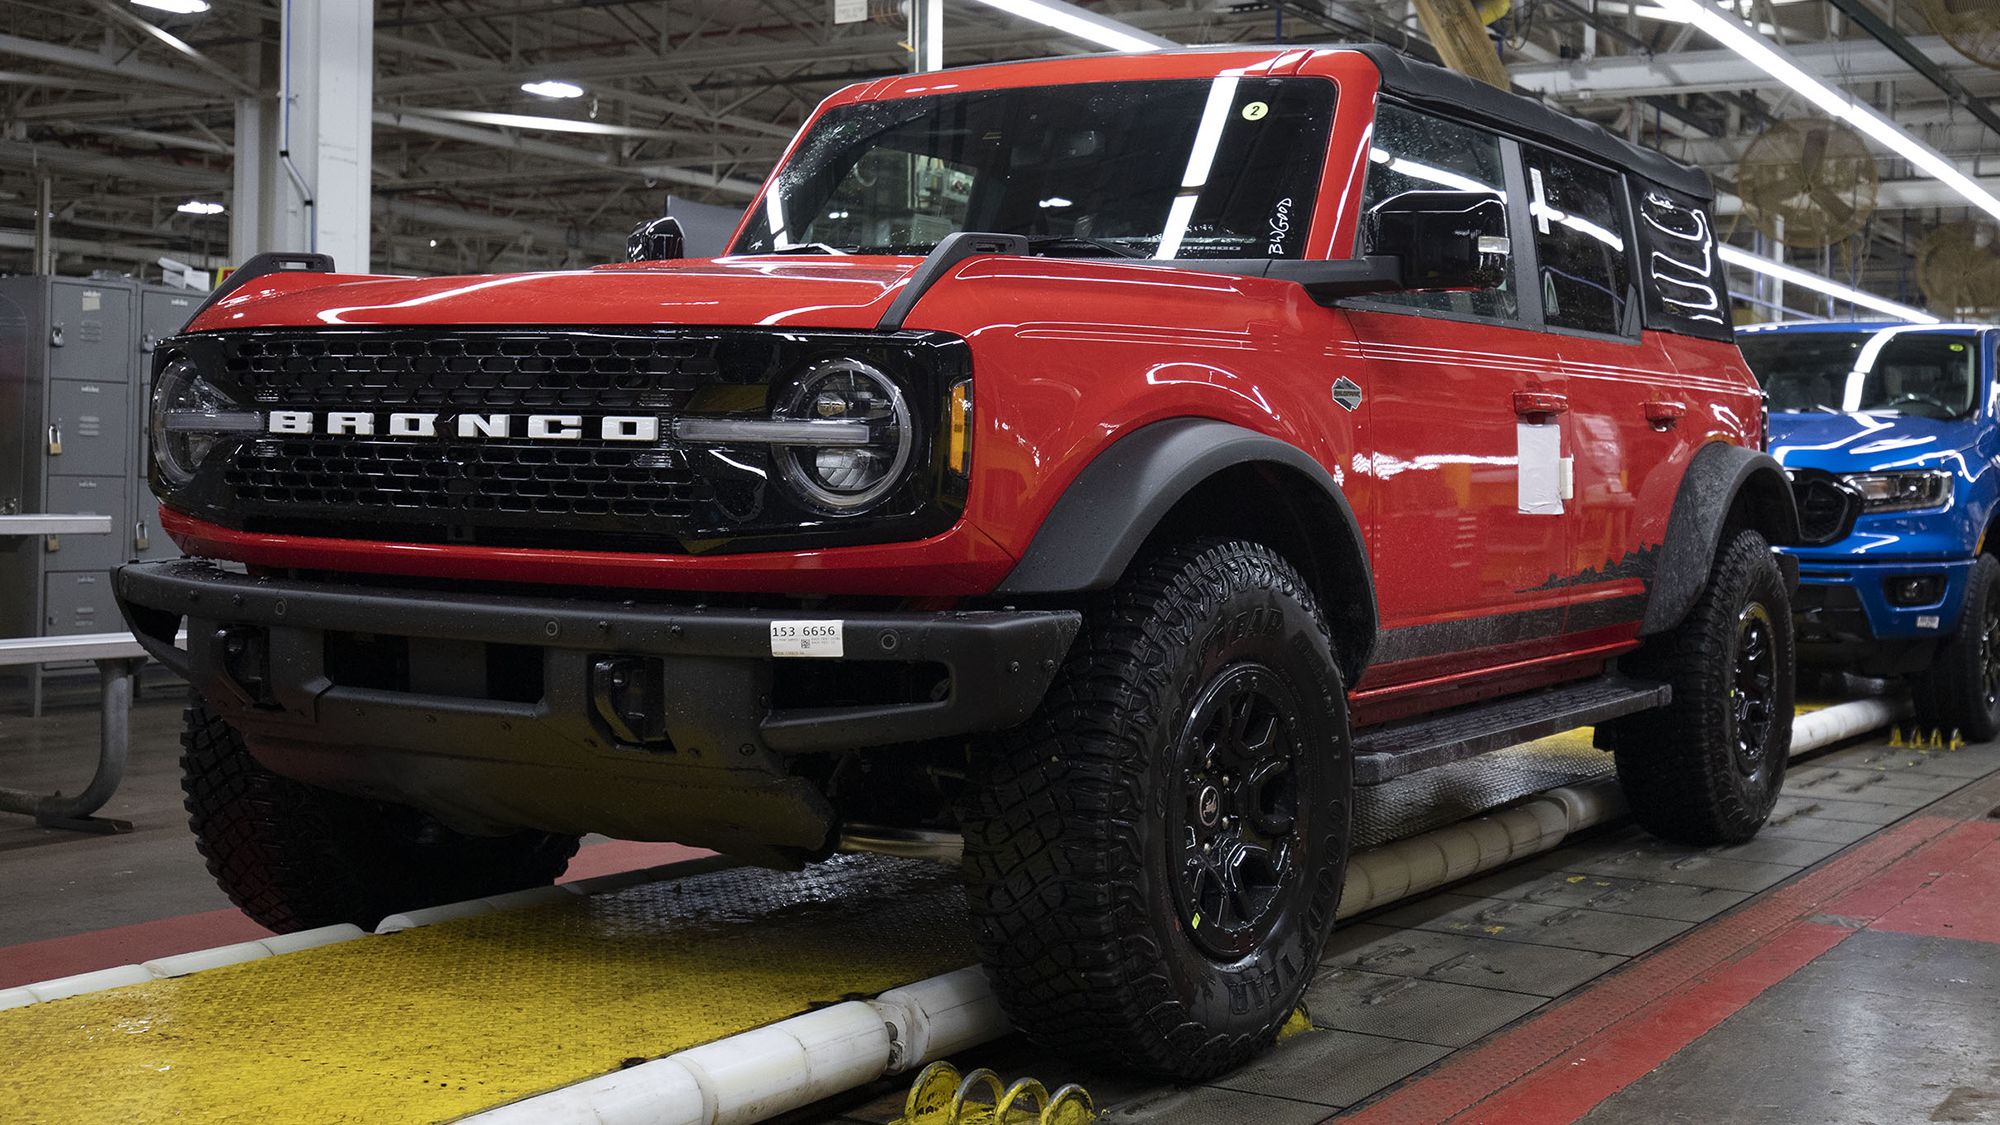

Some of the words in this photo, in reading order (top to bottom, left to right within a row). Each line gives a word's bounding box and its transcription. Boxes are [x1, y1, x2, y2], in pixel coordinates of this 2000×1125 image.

[1250, 105, 1260, 116] 2
[268, 410, 659, 442] BRONCO
[772, 627, 795, 636] 153
[802, 625, 836, 636] 6656
